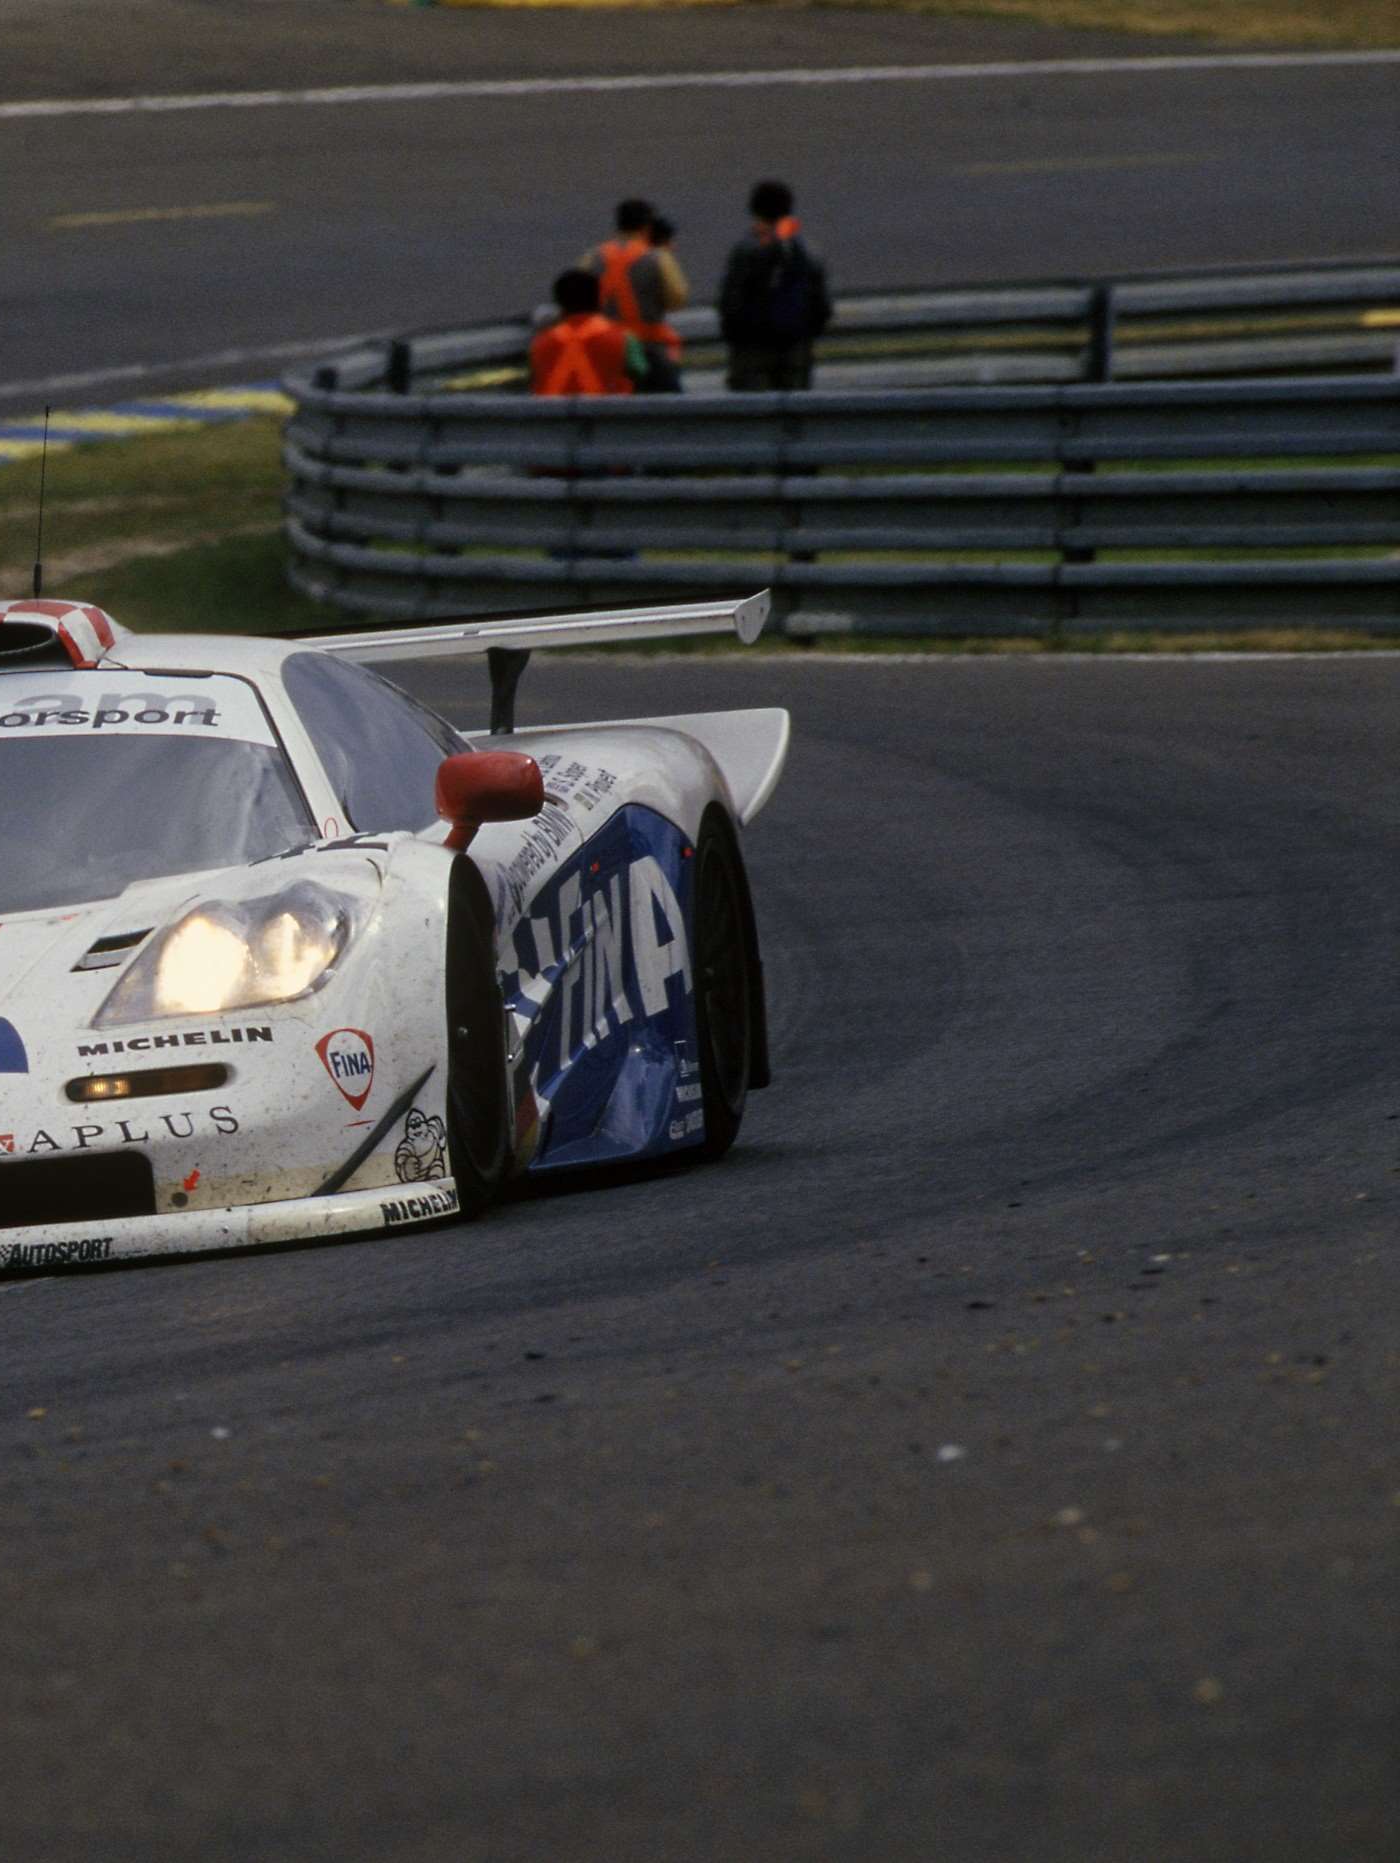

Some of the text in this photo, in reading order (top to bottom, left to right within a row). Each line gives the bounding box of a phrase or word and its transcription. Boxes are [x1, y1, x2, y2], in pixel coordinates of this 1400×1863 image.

[558, 856, 693, 1070] FINA
[78, 1027, 273, 1056] MICHELIN
[331, 1050, 373, 1078] FINA
